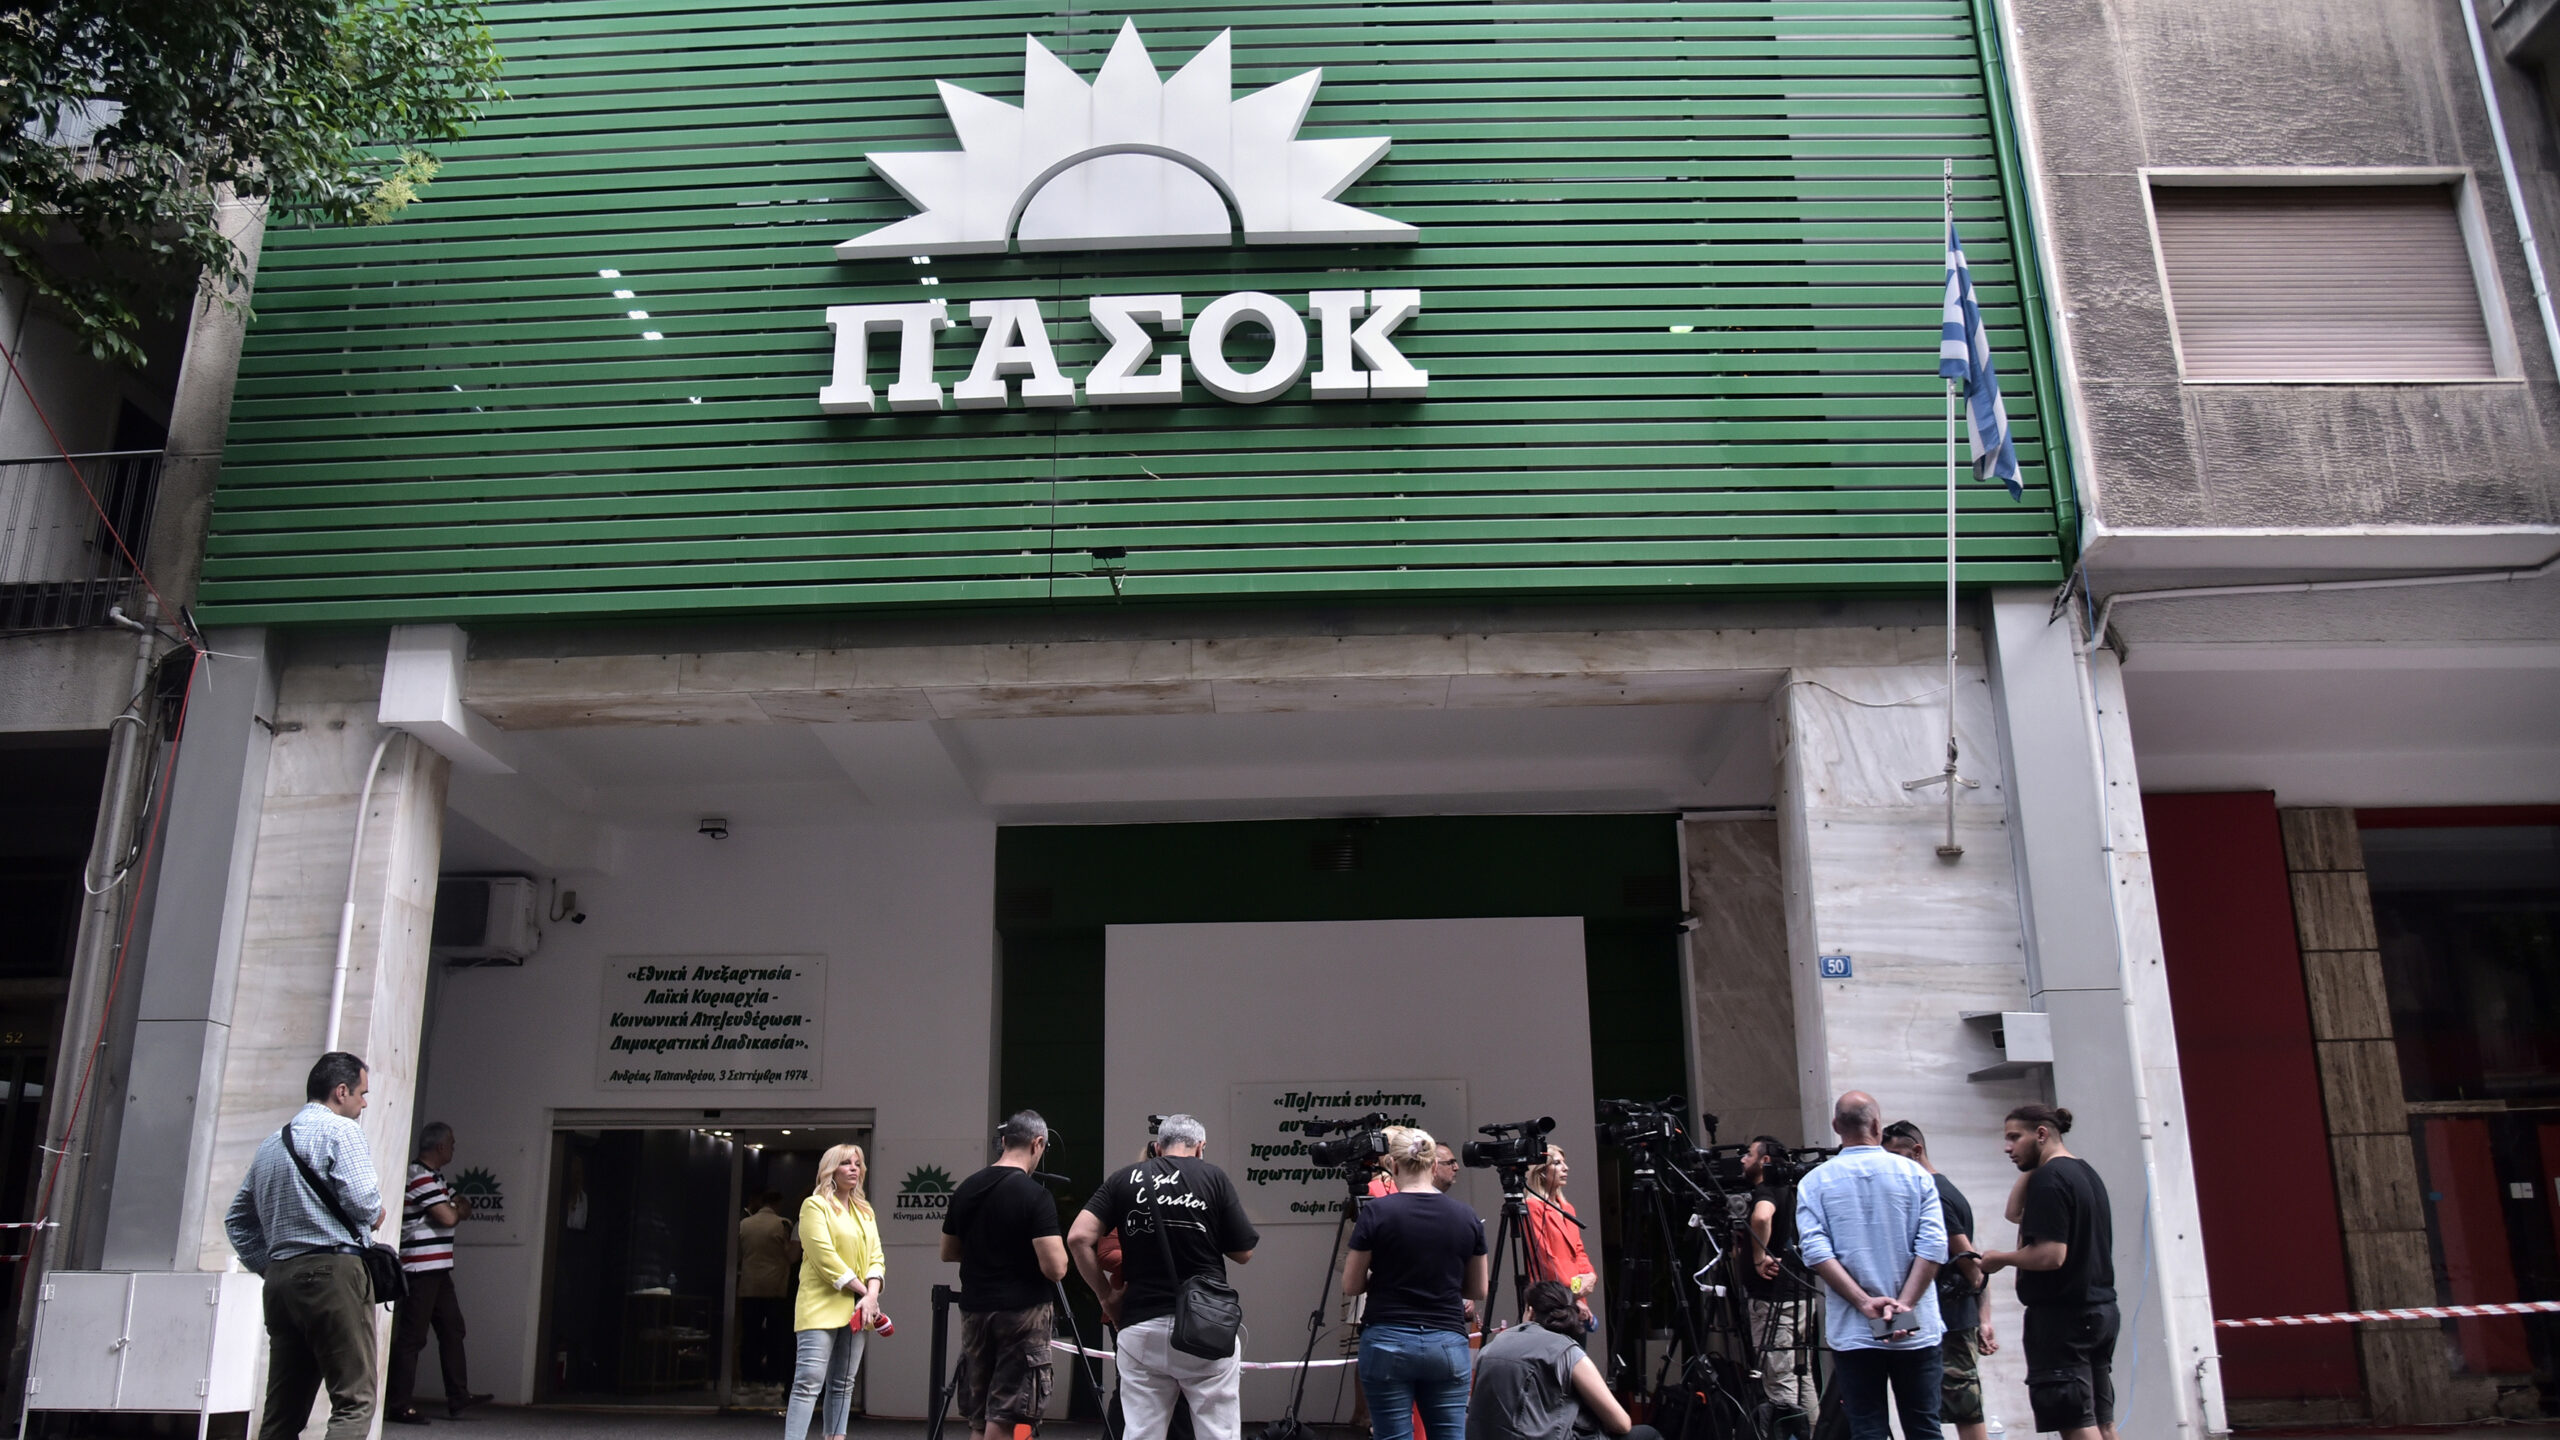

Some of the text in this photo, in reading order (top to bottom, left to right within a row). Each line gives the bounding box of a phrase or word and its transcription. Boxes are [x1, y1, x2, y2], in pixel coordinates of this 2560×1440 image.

[819, 289, 1429, 414] ΠΑΣΟΚ
[627, 965, 687, 982] «Εθνική
[692, 964, 792, 985] Ανεξαρτησία
[1828, 959, 1845, 974] 50
[643, 988, 688, 1004] Λαϊκή
[691, 988, 769, 1008] Κυριαρχία
[610, 1012, 688, 1027] Κοινωνική
[690, 1011, 802, 1031] Απελευθέρωση
[6, 1031, 24, 1044] 52
[610, 1034, 809, 1055] Δημοκρατική Διαδικασία».
[609, 1069, 808, 1084] Ανδρέας Παπανδρέου, 3 Σεπτέμβρη 1974
[1274, 1090, 1426, 1112] «Πολιτική ενότητα,
[1251, 1140, 1313, 1161] προοδε
[470, 1196, 504, 1209] ΣΟΚ
[1136, 1187, 1208, 1210] Oerator
[1290, 1201, 1325, 1216] Φώφη
[893, 1211, 947, 1221] Κίνημα Αλλα
